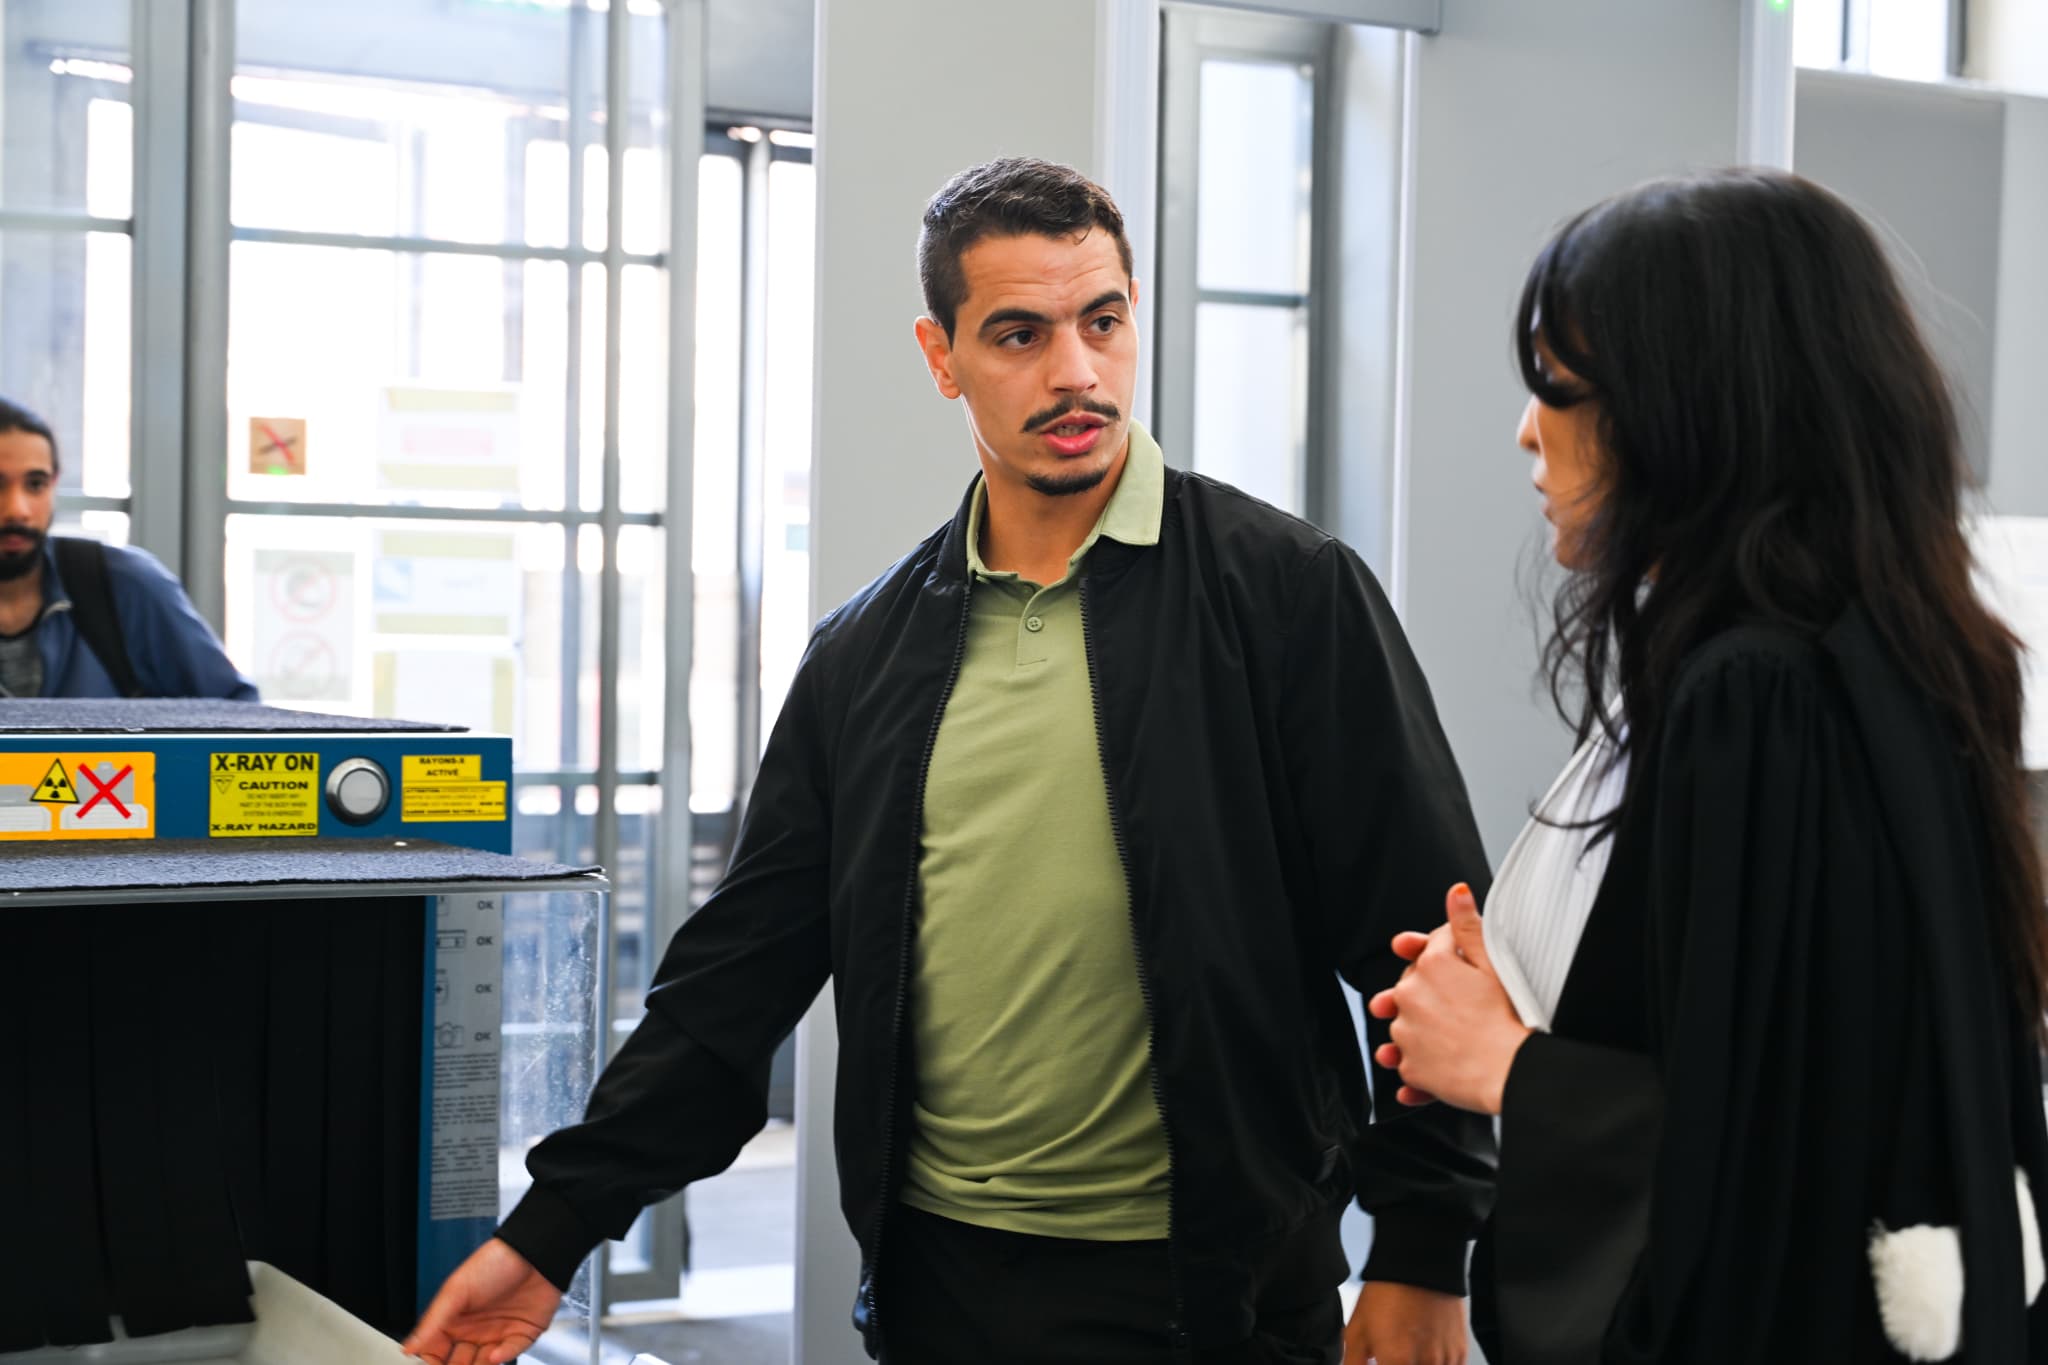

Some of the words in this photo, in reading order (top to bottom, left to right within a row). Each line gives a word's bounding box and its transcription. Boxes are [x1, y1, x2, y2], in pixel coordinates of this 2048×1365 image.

[215, 754, 277, 771] X-RAY
[284, 754, 314, 771] ON
[419, 757, 465, 765] RAYONS-X
[239, 781, 309, 790] CAUTION
[211, 823, 254, 831] X-RAY
[258, 823, 316, 831] HAZARD
[477, 900, 494, 910] OK
[476, 936, 493, 946] OK
[475, 984, 492, 994] OK
[474, 1031, 491, 1042] OK
